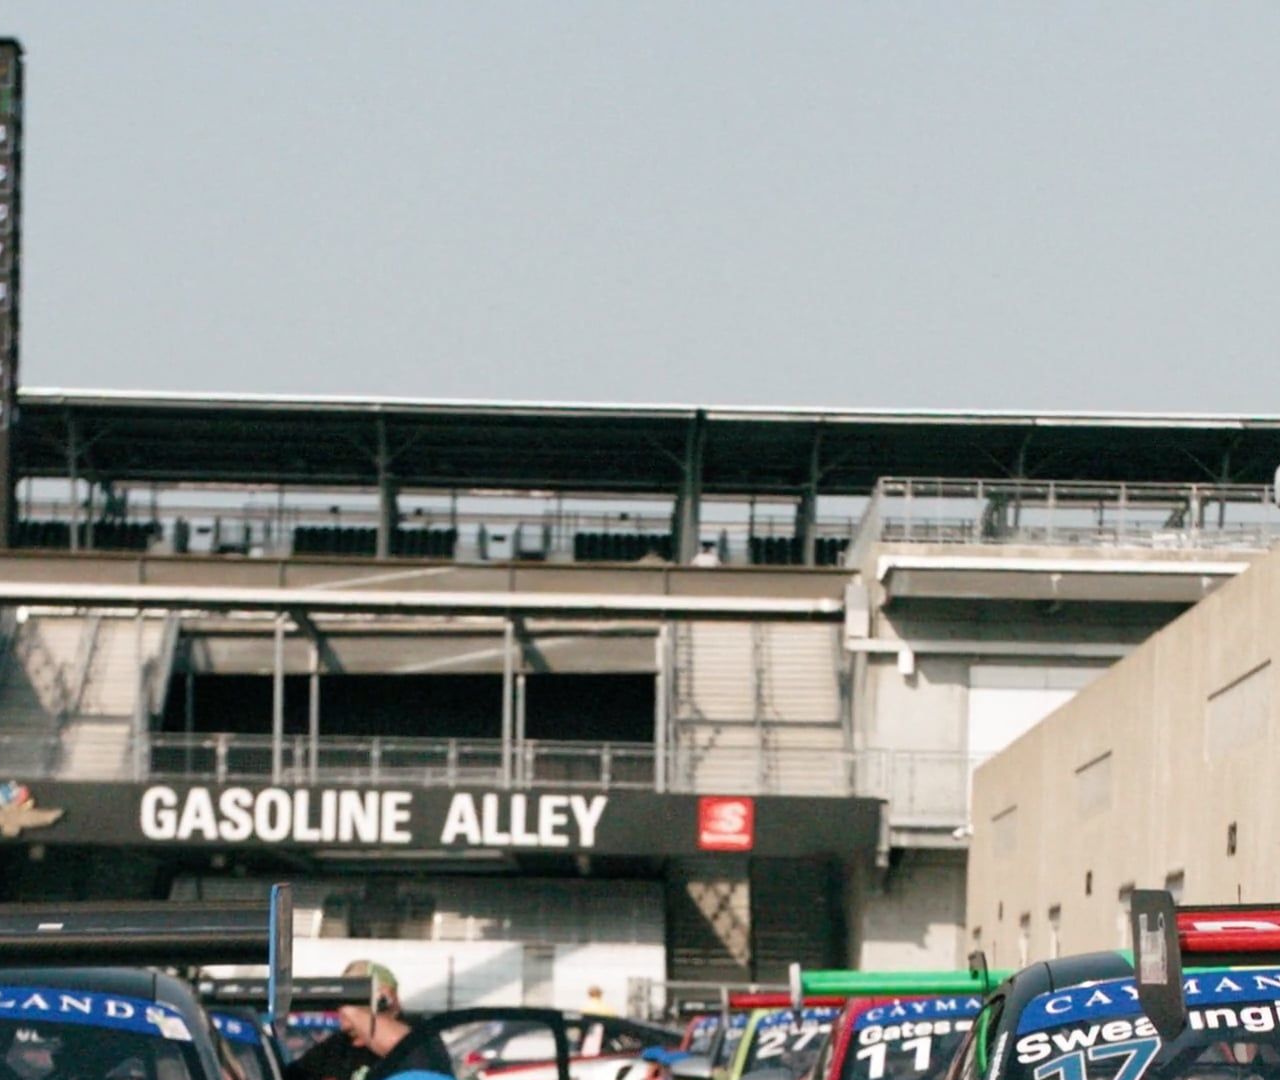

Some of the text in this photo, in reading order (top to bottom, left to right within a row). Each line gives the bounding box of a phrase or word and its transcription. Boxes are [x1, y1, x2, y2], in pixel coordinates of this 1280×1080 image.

[139, 786, 607, 848] GASOLINE ALLEY
[755, 1026, 819, 1060] 27
[859, 1020, 951, 1046] Gates
[856, 1037, 933, 1080] 11
